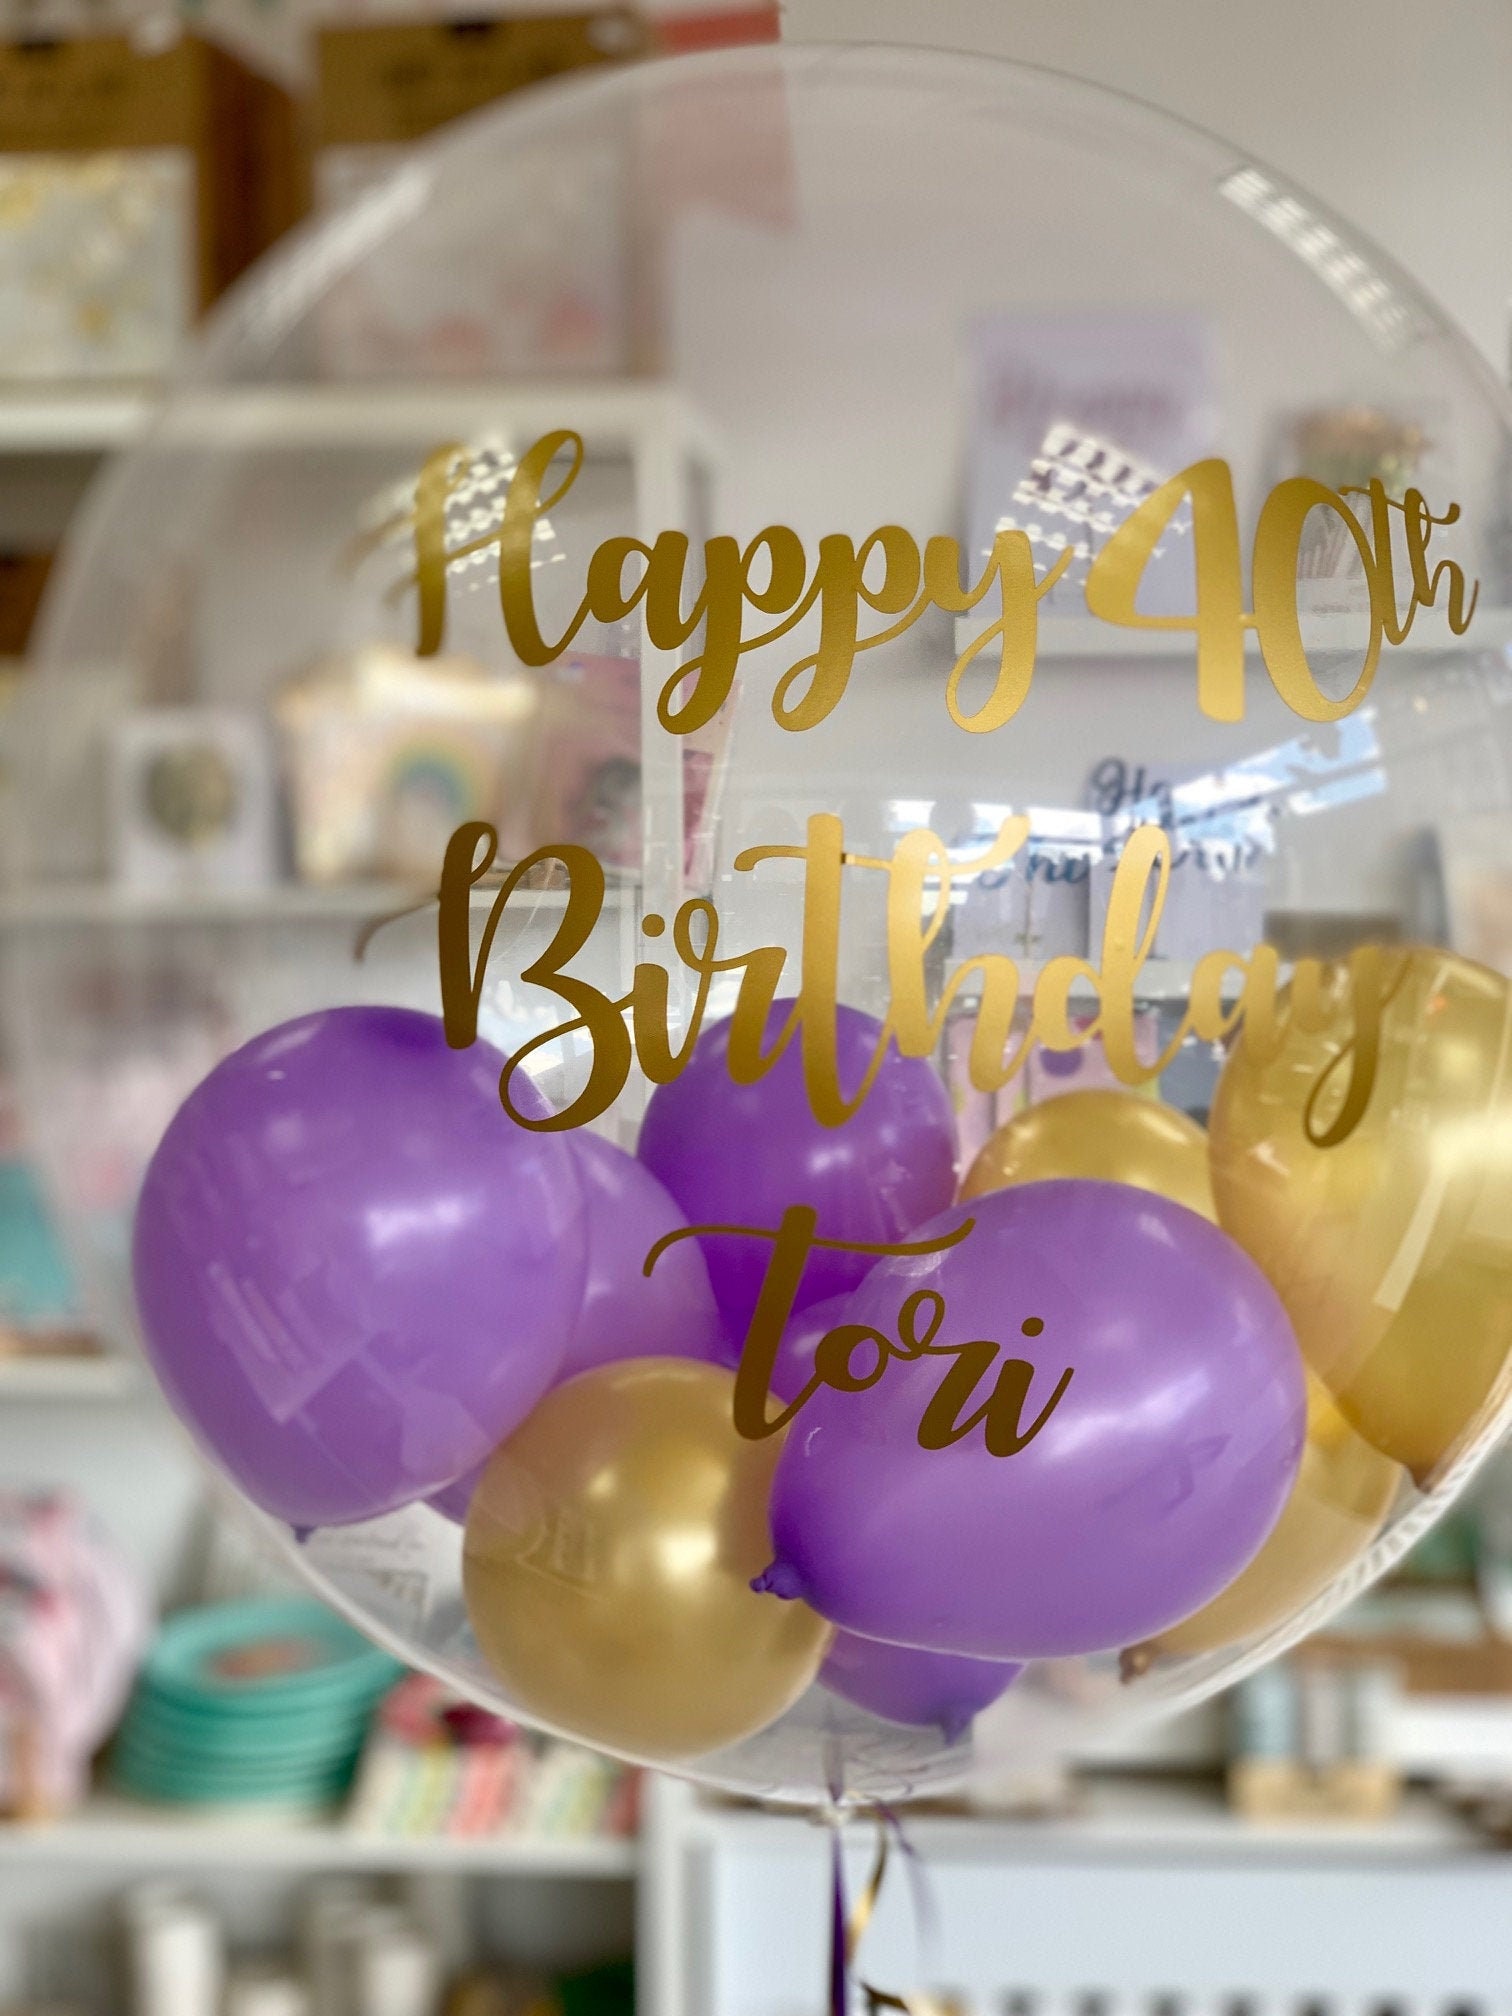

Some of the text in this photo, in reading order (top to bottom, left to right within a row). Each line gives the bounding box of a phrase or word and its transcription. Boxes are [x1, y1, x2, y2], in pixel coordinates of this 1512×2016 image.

[350, 430, 1479, 735] Happy 40th
[355, 813, 1412, 1148] Birthday
